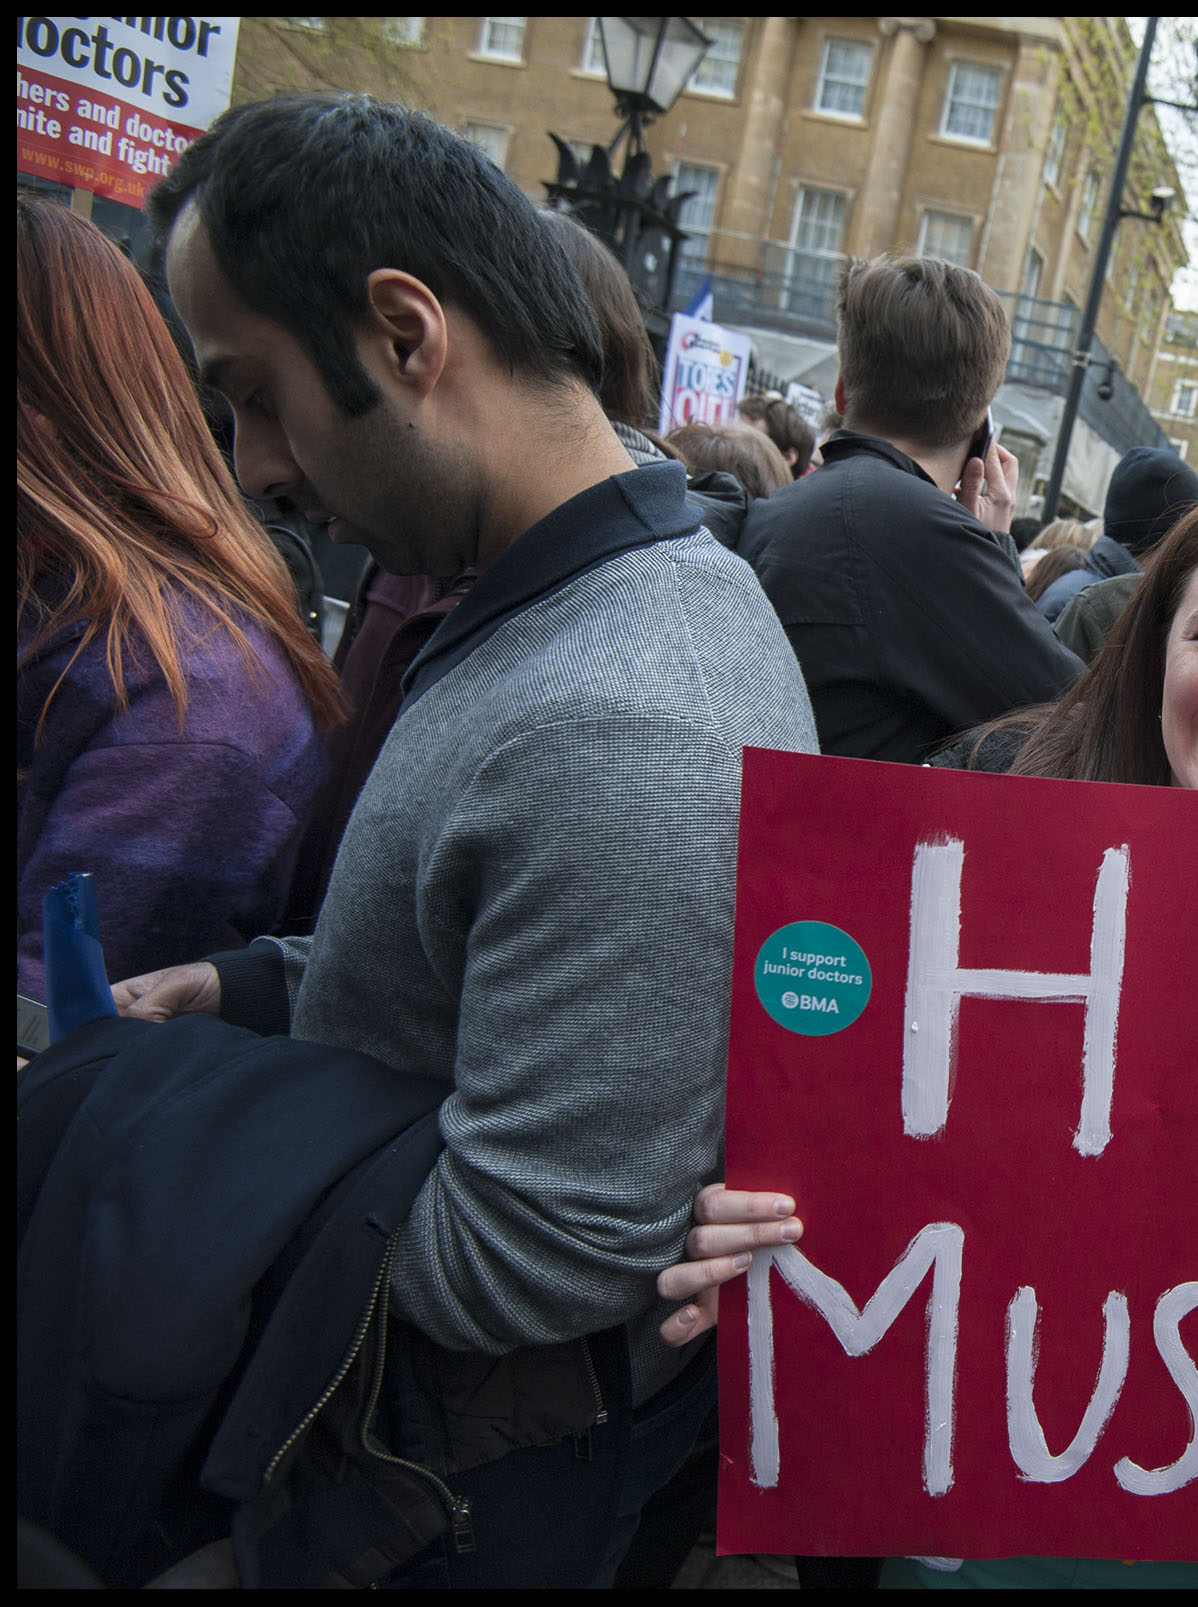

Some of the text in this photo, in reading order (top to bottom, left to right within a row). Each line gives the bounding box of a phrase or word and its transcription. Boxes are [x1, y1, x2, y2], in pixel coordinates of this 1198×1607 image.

[17, 17, 190, 108] octors
[69, 125, 113, 156] and
[119, 138, 172, 175] fight
[77, 99, 120, 130] and
[126, 114, 194, 155] docto
[22, 148, 145, 196] www.swp.org.uk
[763, 960, 863, 985] junior doctors
[781, 946, 847, 968] I support
[800, 994, 840, 1014] BMA
